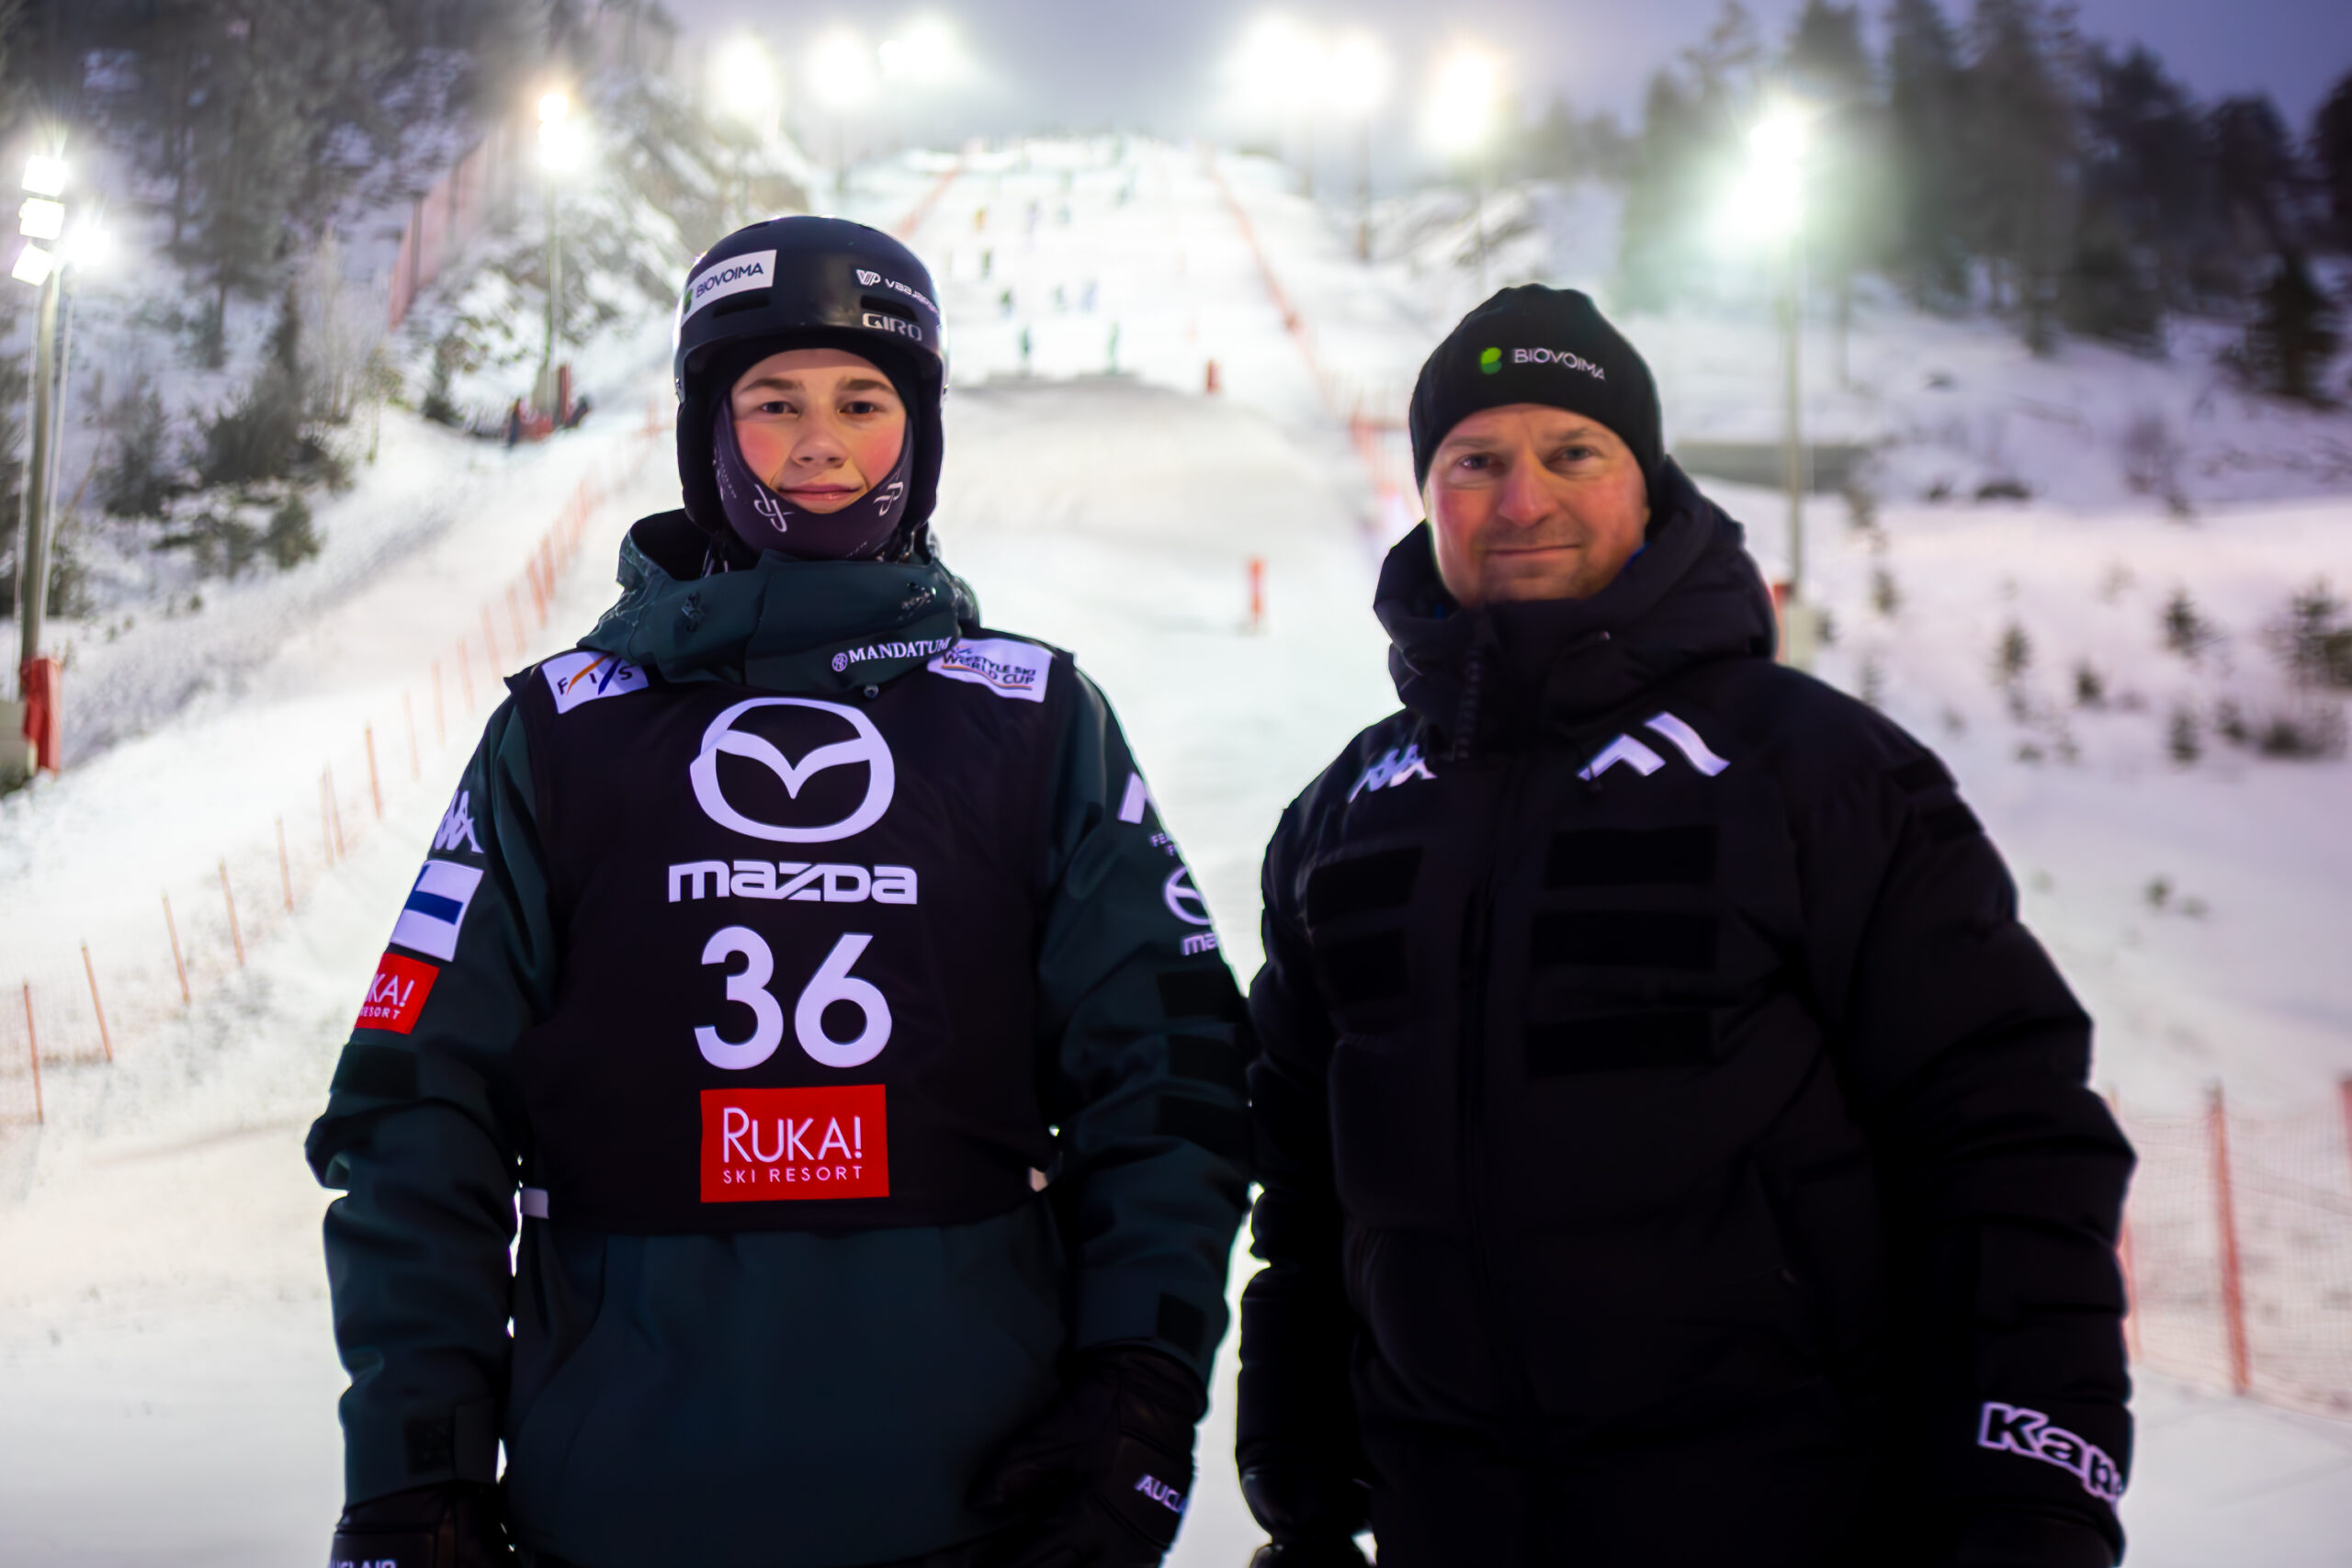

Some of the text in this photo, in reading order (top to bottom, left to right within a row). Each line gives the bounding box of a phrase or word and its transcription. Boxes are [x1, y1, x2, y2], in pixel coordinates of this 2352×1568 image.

[695, 262, 764, 299] BIOVOIMA
[862, 312, 922, 342] GIRO
[1513, 347, 1607, 381] BIOVOIMA
[847, 636, 954, 664] MANDATUM
[556, 664, 633, 695] FIS
[1002, 672, 1035, 684] CUP
[1014, 665, 1037, 677] SKI
[1182, 931, 1216, 956] ma
[366, 973, 415, 1008] KA!
[693, 924, 893, 1070] 36
[722, 1106, 864, 1164] RUKA!
[722, 1165, 863, 1185] SKI RESORT
